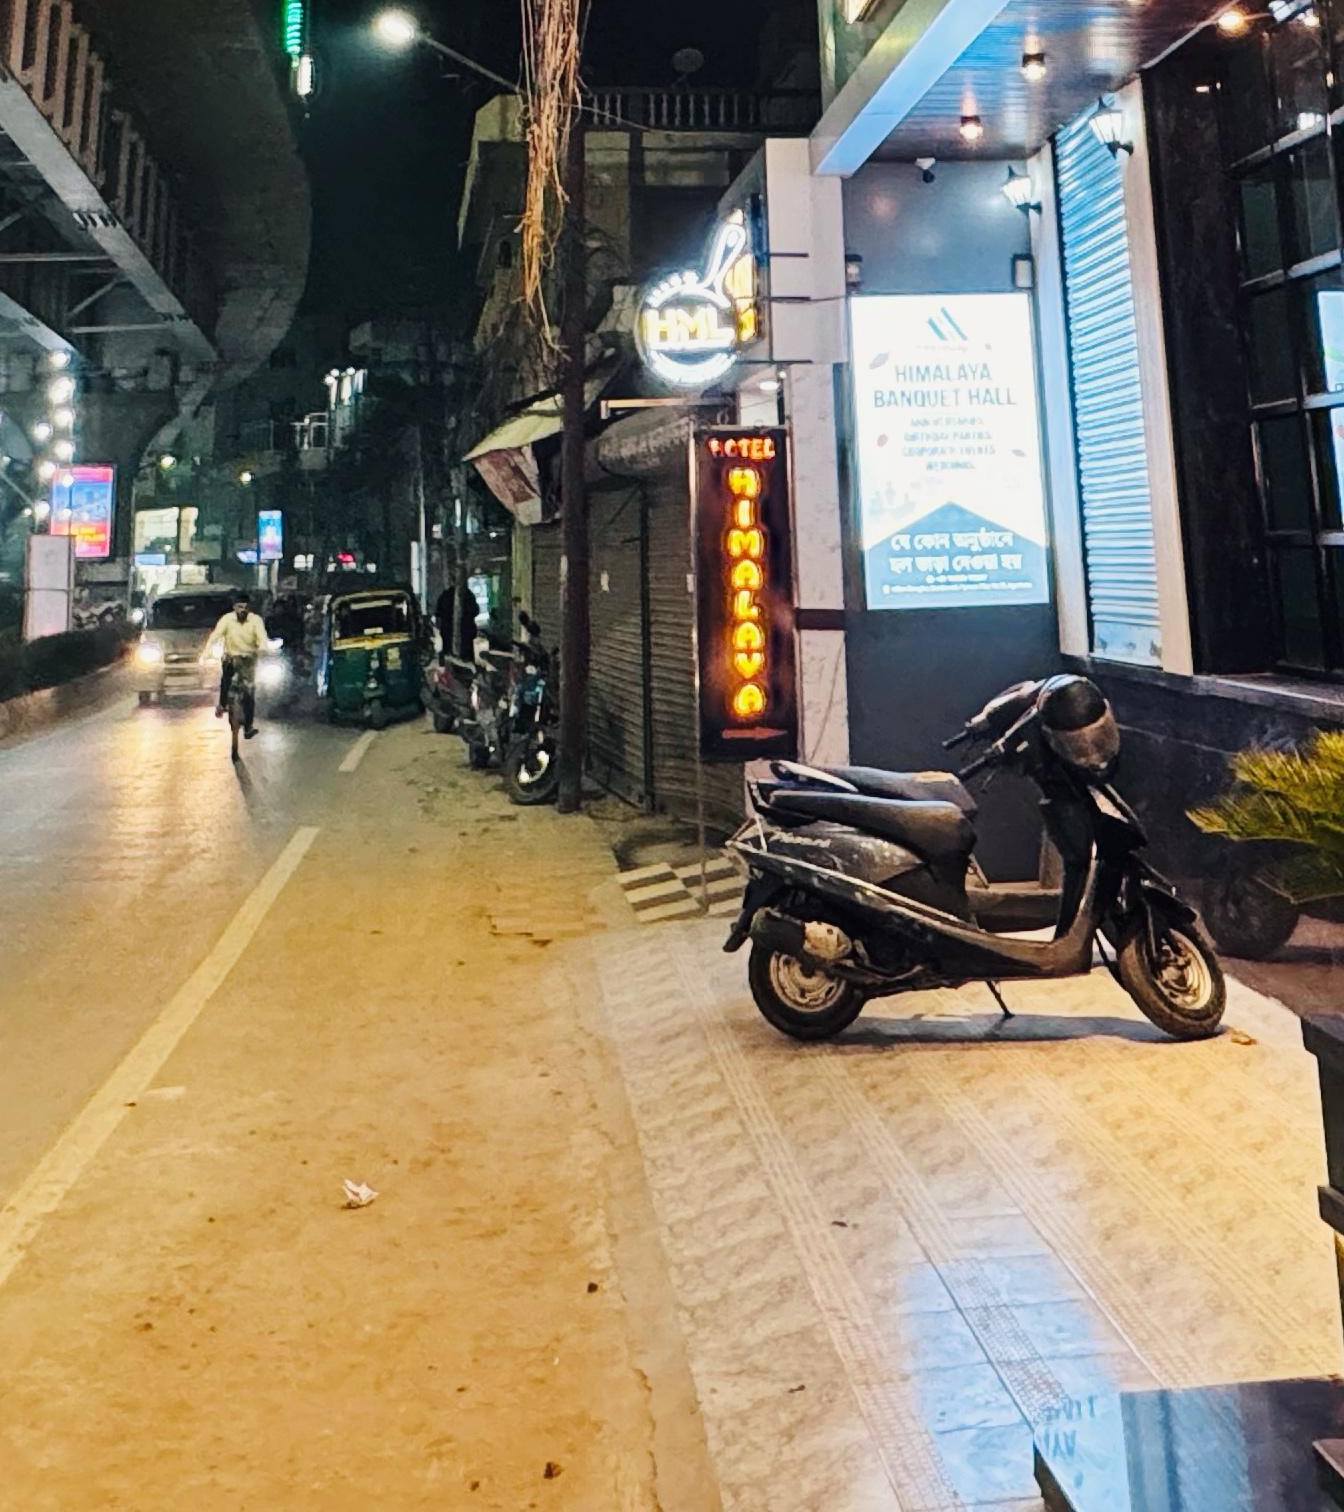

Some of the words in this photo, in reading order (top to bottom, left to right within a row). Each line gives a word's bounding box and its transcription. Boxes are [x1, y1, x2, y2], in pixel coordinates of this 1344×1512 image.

[640, 303, 736, 349] HML
[894, 362, 993, 383] HIMALAYA
[874, 389, 960, 408] BANQUET
[968, 387, 1017, 406] HALL
